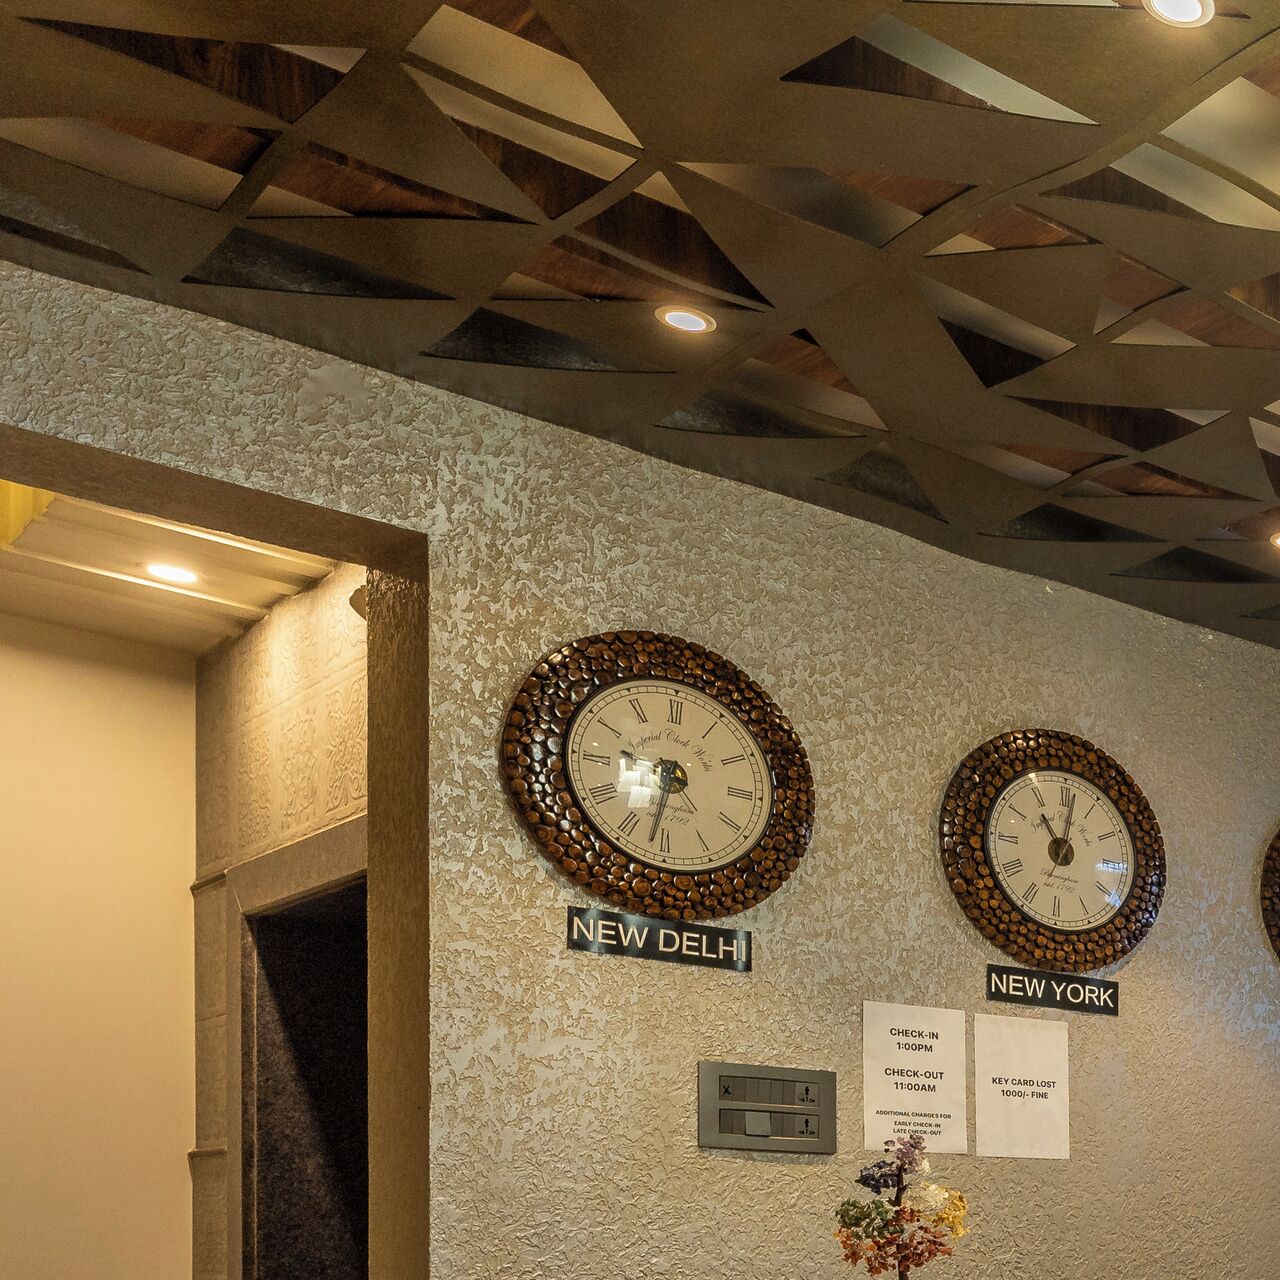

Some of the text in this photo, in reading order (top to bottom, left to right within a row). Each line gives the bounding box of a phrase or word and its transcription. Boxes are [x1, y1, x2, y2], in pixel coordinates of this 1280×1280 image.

[629, 698, 648, 724] XI
[667, 699, 683, 725] XII
[664, 728, 690, 748] Clock
[573, 916, 747, 962] NEW DELHI
[991, 973, 1114, 1007] NEW YORK
[889, 1027, 939, 1040] CHECK-IN
[896, 1041, 933, 1053] 1:00PM
[884, 1067, 945, 1080] CHECK-OUT
[893, 1081, 937, 1093] 11:00AM
[991, 1076, 1057, 1089] KEY CARD LOST
[1000, 1089, 1049, 1100] 1000/- FINE
